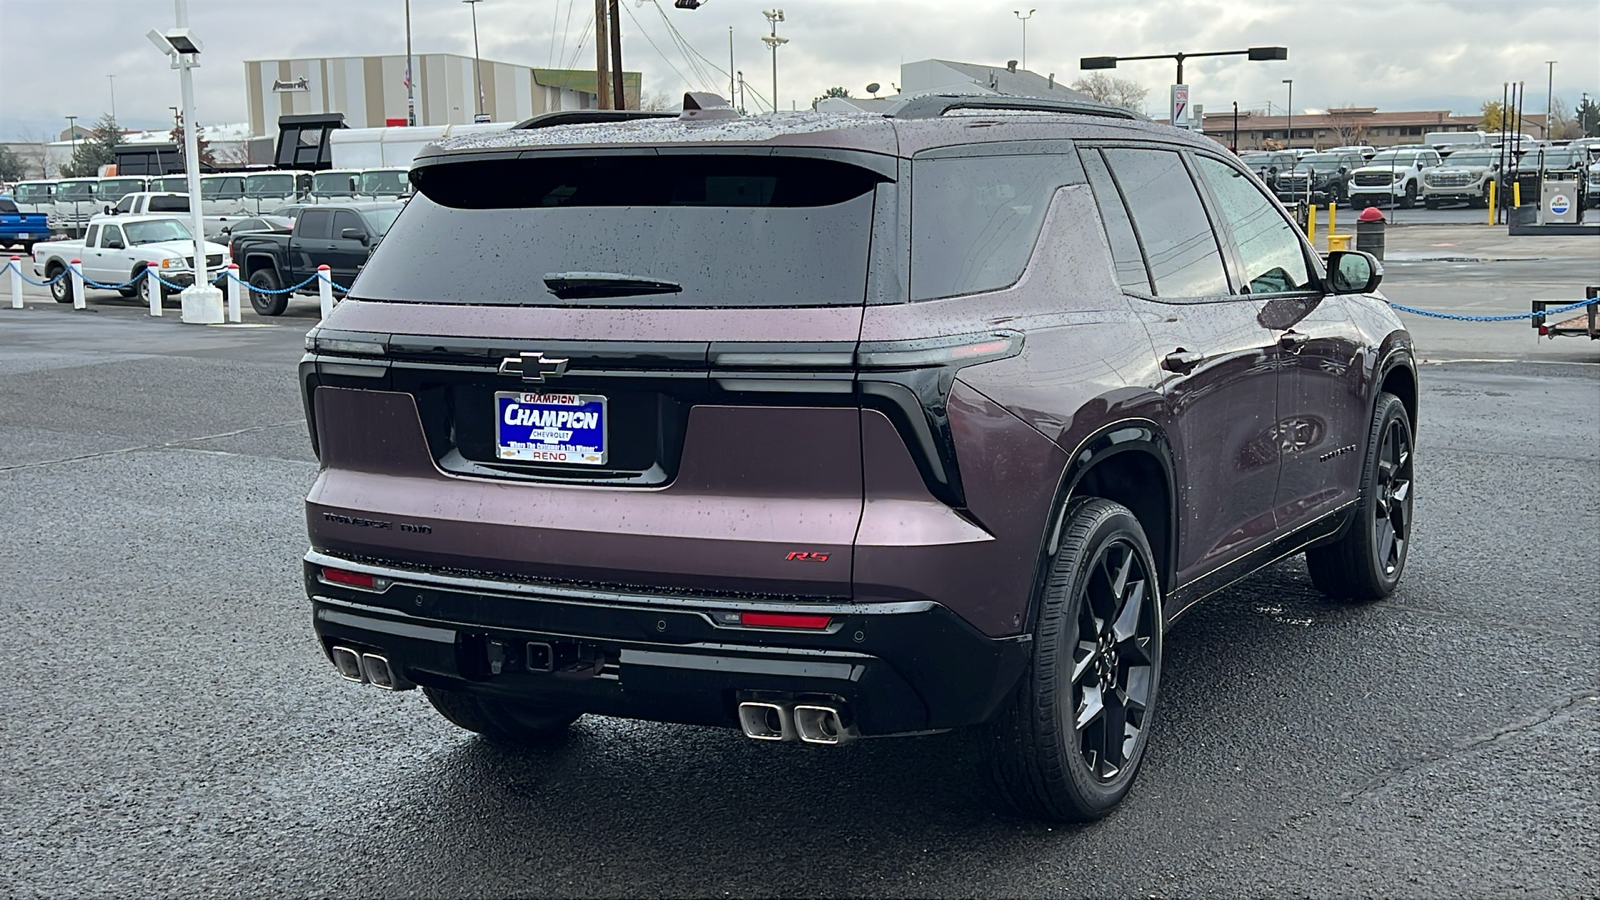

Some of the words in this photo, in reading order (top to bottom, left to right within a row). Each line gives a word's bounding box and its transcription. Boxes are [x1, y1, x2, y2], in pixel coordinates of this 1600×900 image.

[524, 394, 575, 404] CHAMPION
[504, 404, 598, 429] CHAMPION
[532, 430, 569, 439] CHEVROLET
[533, 451, 567, 462] RENO
[323, 512, 393, 531] TRAVERSE
[785, 551, 832, 562] RS
